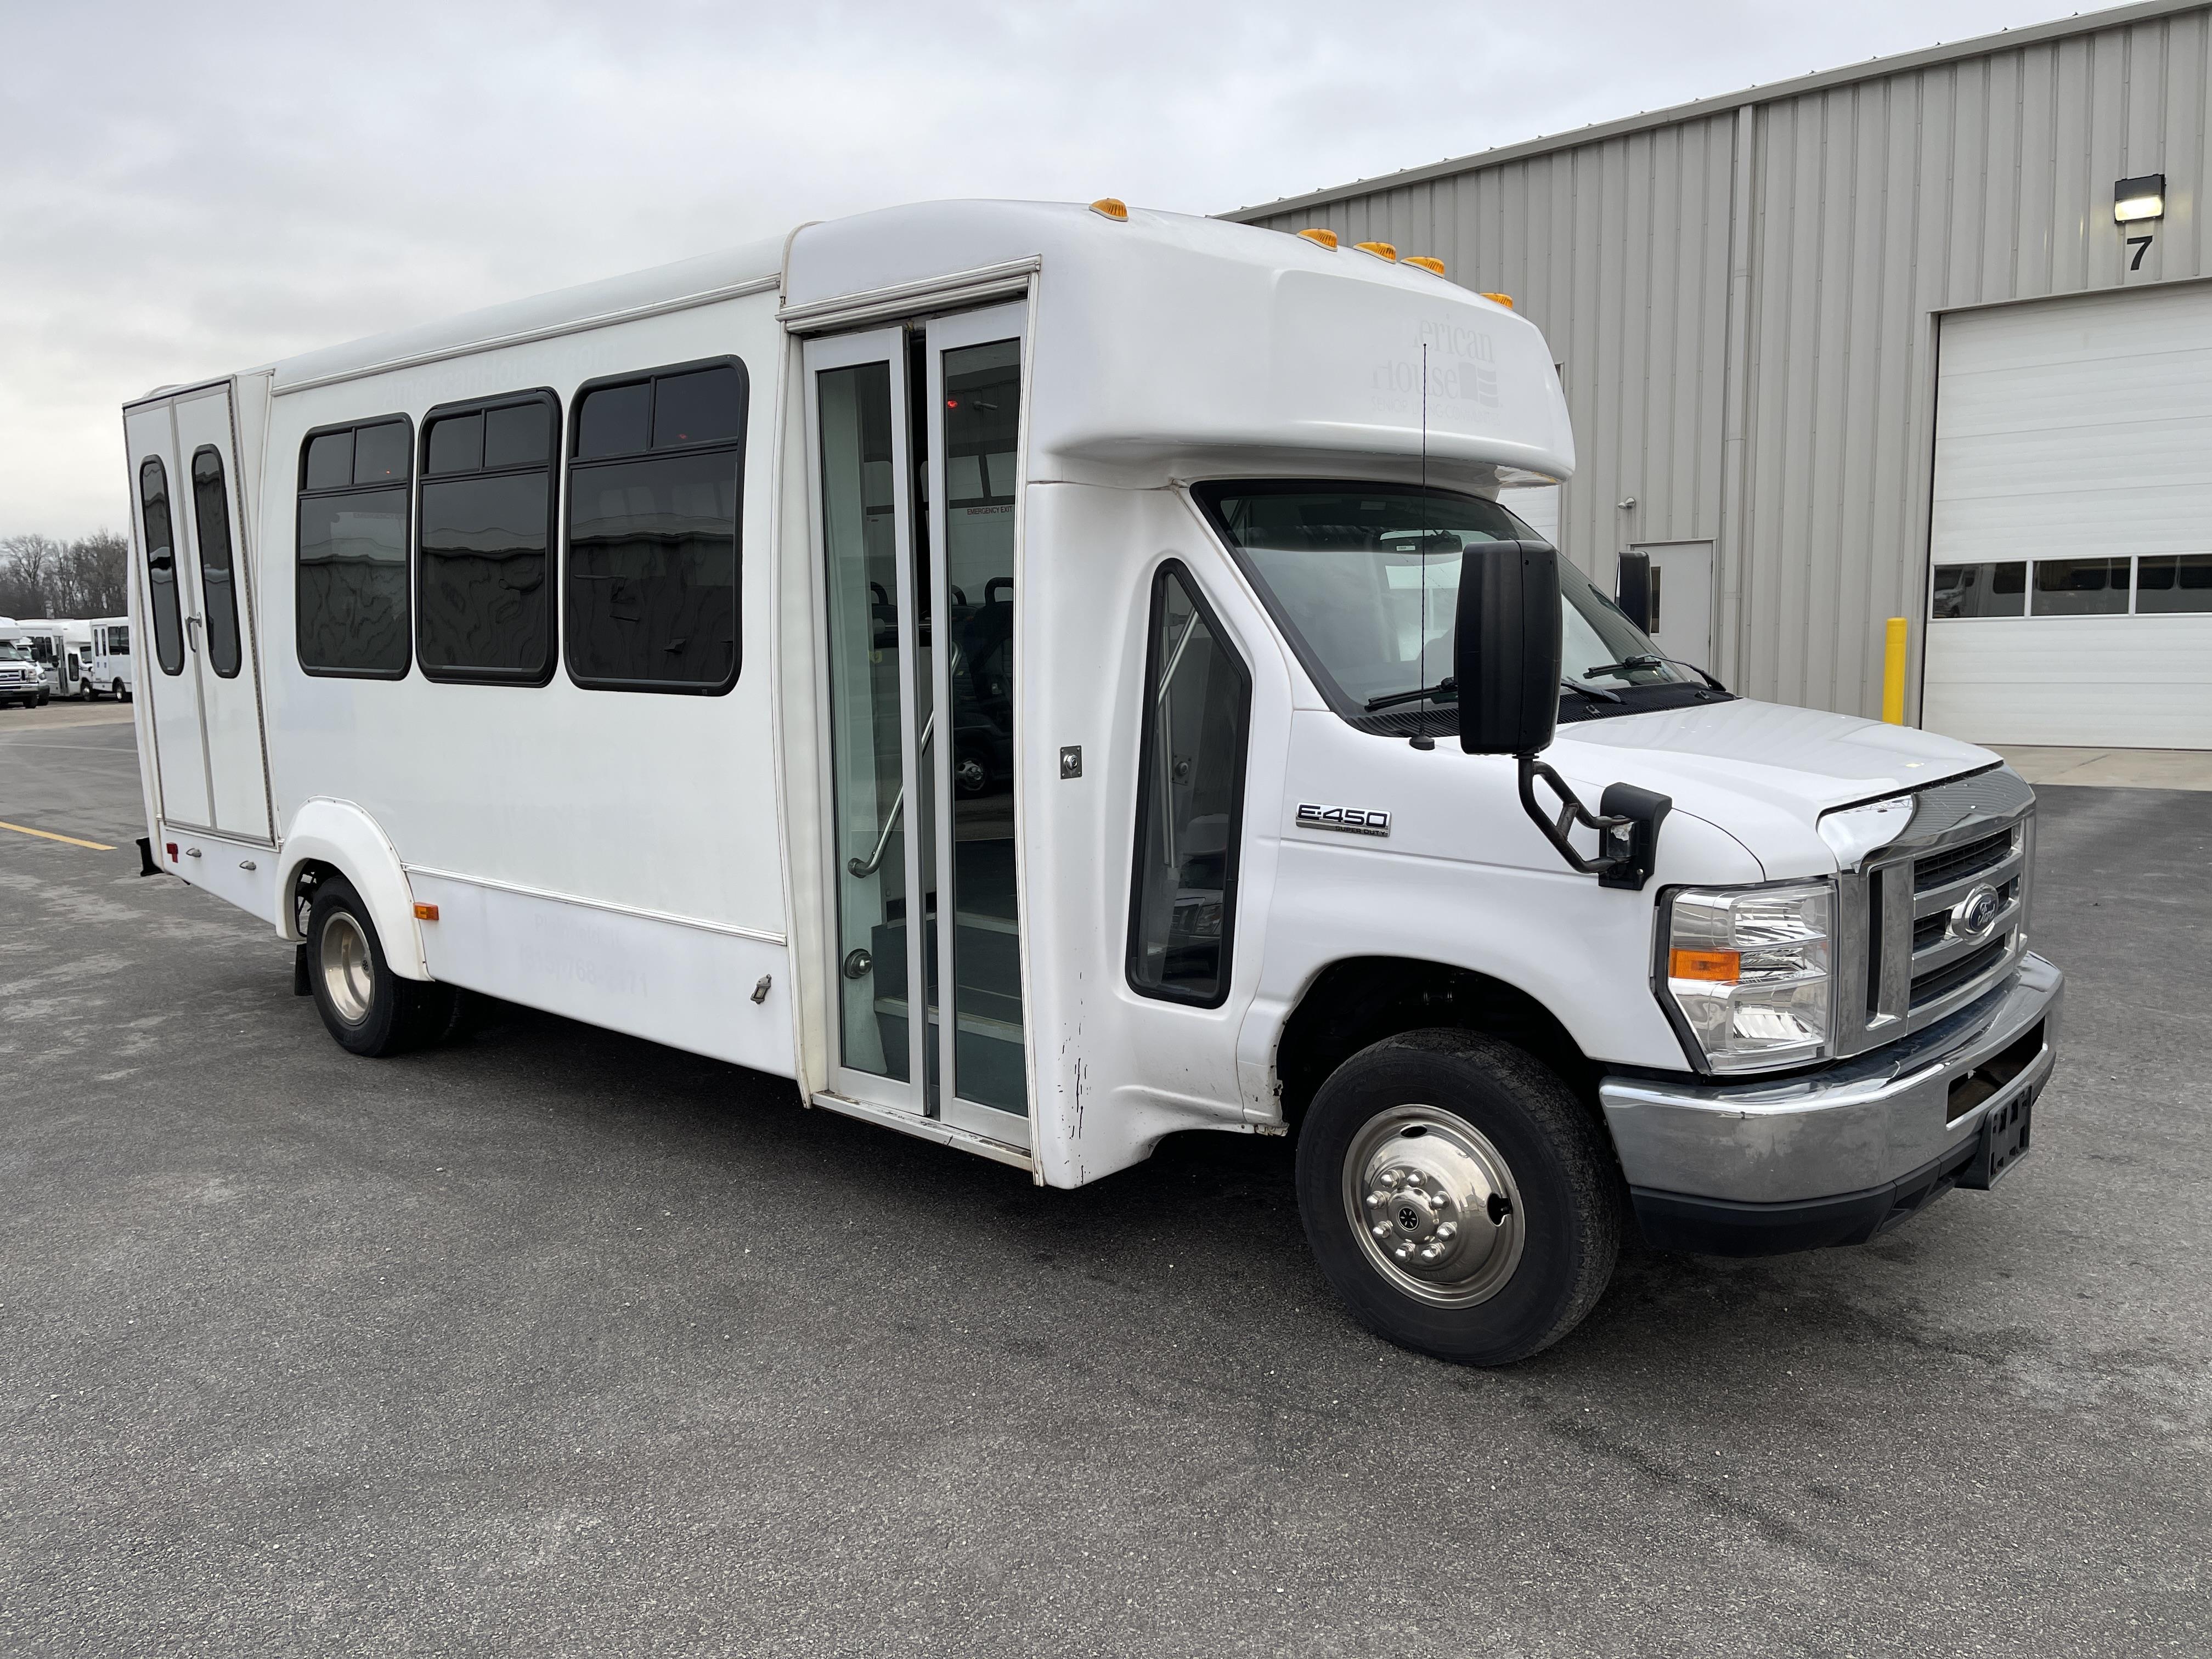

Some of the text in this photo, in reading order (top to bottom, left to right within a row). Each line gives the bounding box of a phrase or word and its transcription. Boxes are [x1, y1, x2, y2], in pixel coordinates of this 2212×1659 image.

[2126, 235, 2153, 270] 7
[967, 507, 1000, 515] EMERGENCY
[1297, 804, 1388, 828] E-450
[1335, 826, 1361, 834] SUPER
[1977, 900, 1996, 924] Ford
